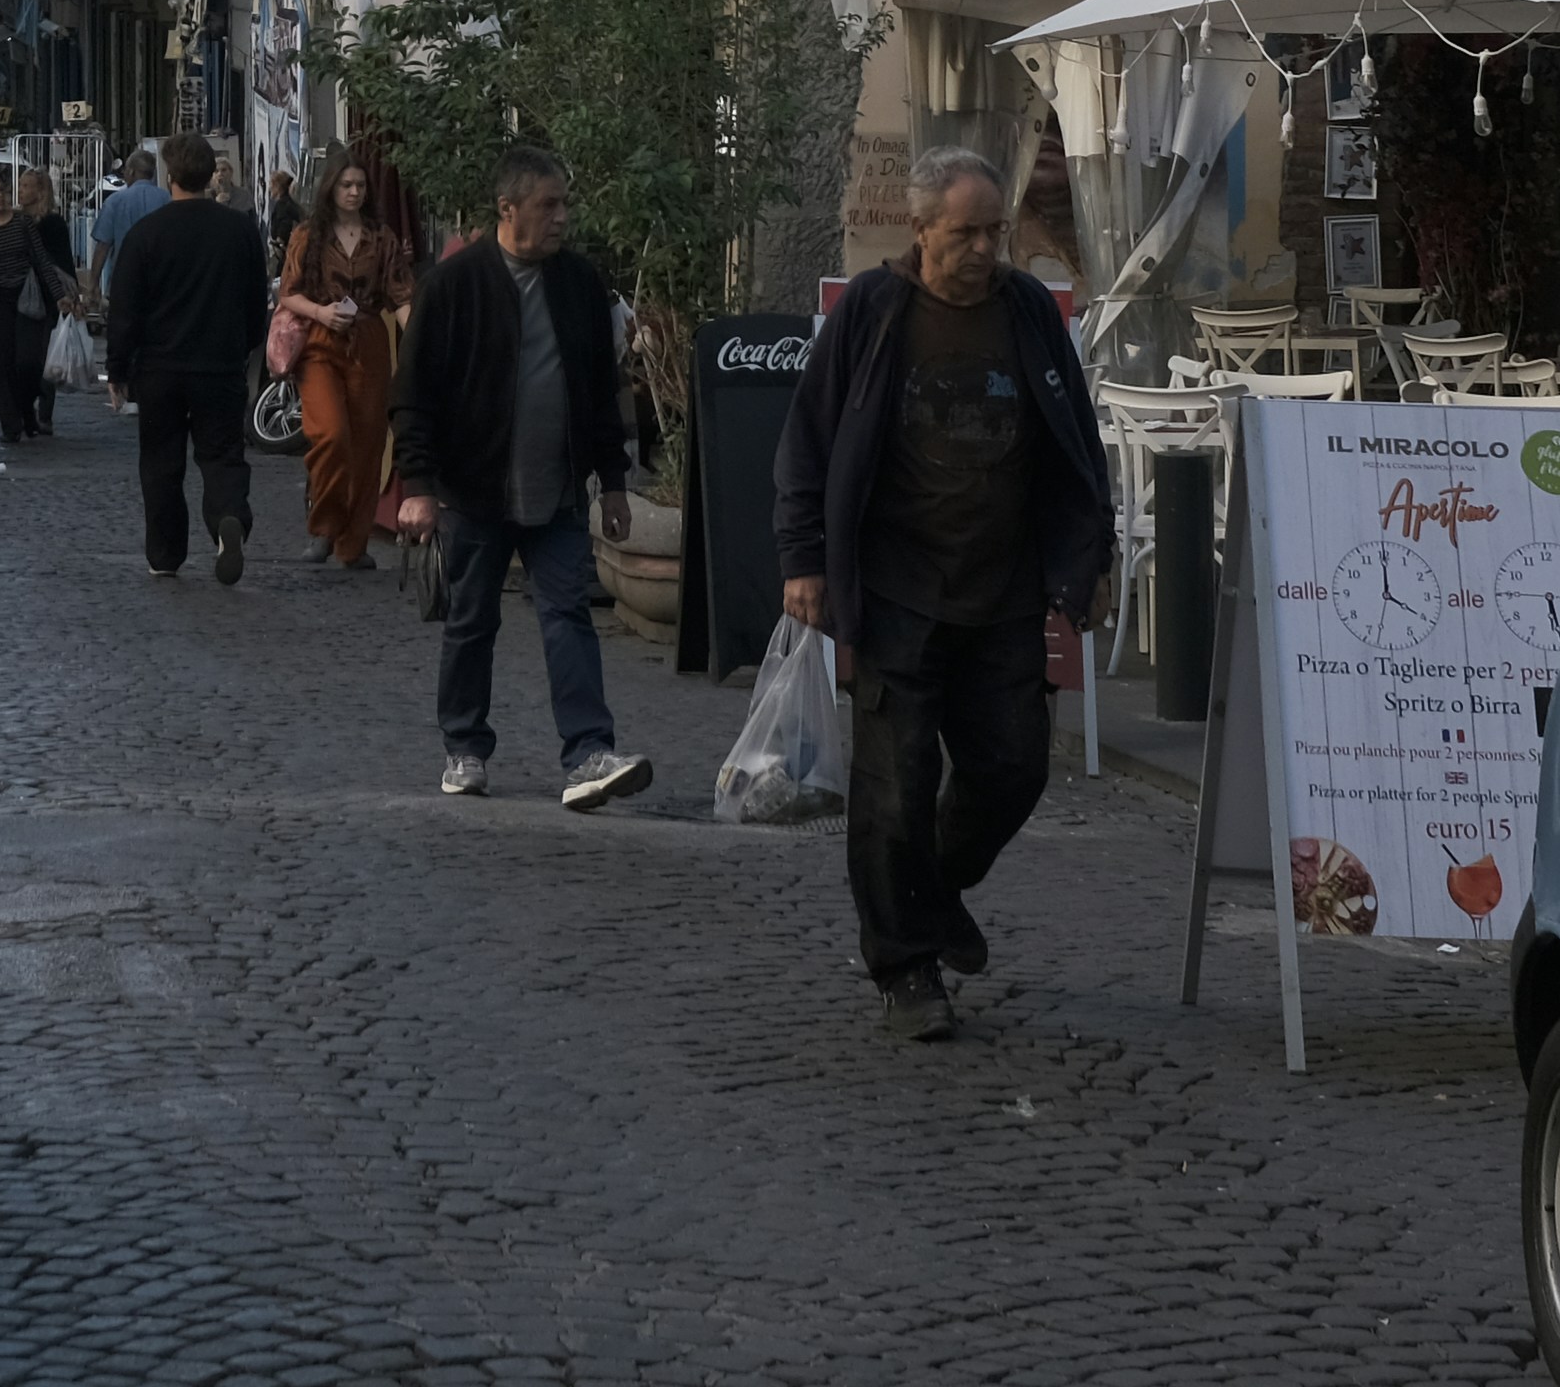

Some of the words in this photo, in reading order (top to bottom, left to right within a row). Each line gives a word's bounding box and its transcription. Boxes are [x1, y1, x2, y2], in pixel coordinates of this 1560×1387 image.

[880, 157, 911, 178] Die
[1327, 435, 1353, 453] IL
[1359, 436, 1510, 459] MIRACOLO
[1277, 581, 1328, 601] dalle
[1447, 588, 1485, 609] alle
[1297, 654, 1350, 675] Pizza
[1356, 663, 1369, 676] o
[1374, 657, 1457, 684] Tagliere
[1463, 666, 1496, 685] per
[1503, 661, 1514, 680] 2
[1384, 692, 1446, 717] Spritz
[1451, 700, 1464, 714] o
[1471, 695, 1522, 716] Birra
[1295, 740, 1329, 755] Pizza
[1333, 746, 1350, 756] ou
[1354, 742, 1406, 760] planche
[1409, 748, 1440, 762] pour
[1444, 746, 1453, 760] 2
[1457, 749, 1526, 766] personnes
[1309, 784, 1345, 799] Pizza
[1349, 789, 1364, 799] or
[1368, 785, 1413, 803] platter
[1416, 786, 1437, 801] for
[1440, 788, 1449, 802] 2
[1453, 790, 1501, 807] people
[1504, 790, 1538, 808] Sprit
[1426, 821, 1478, 839] euro
[1487, 818, 1512, 840] 15
